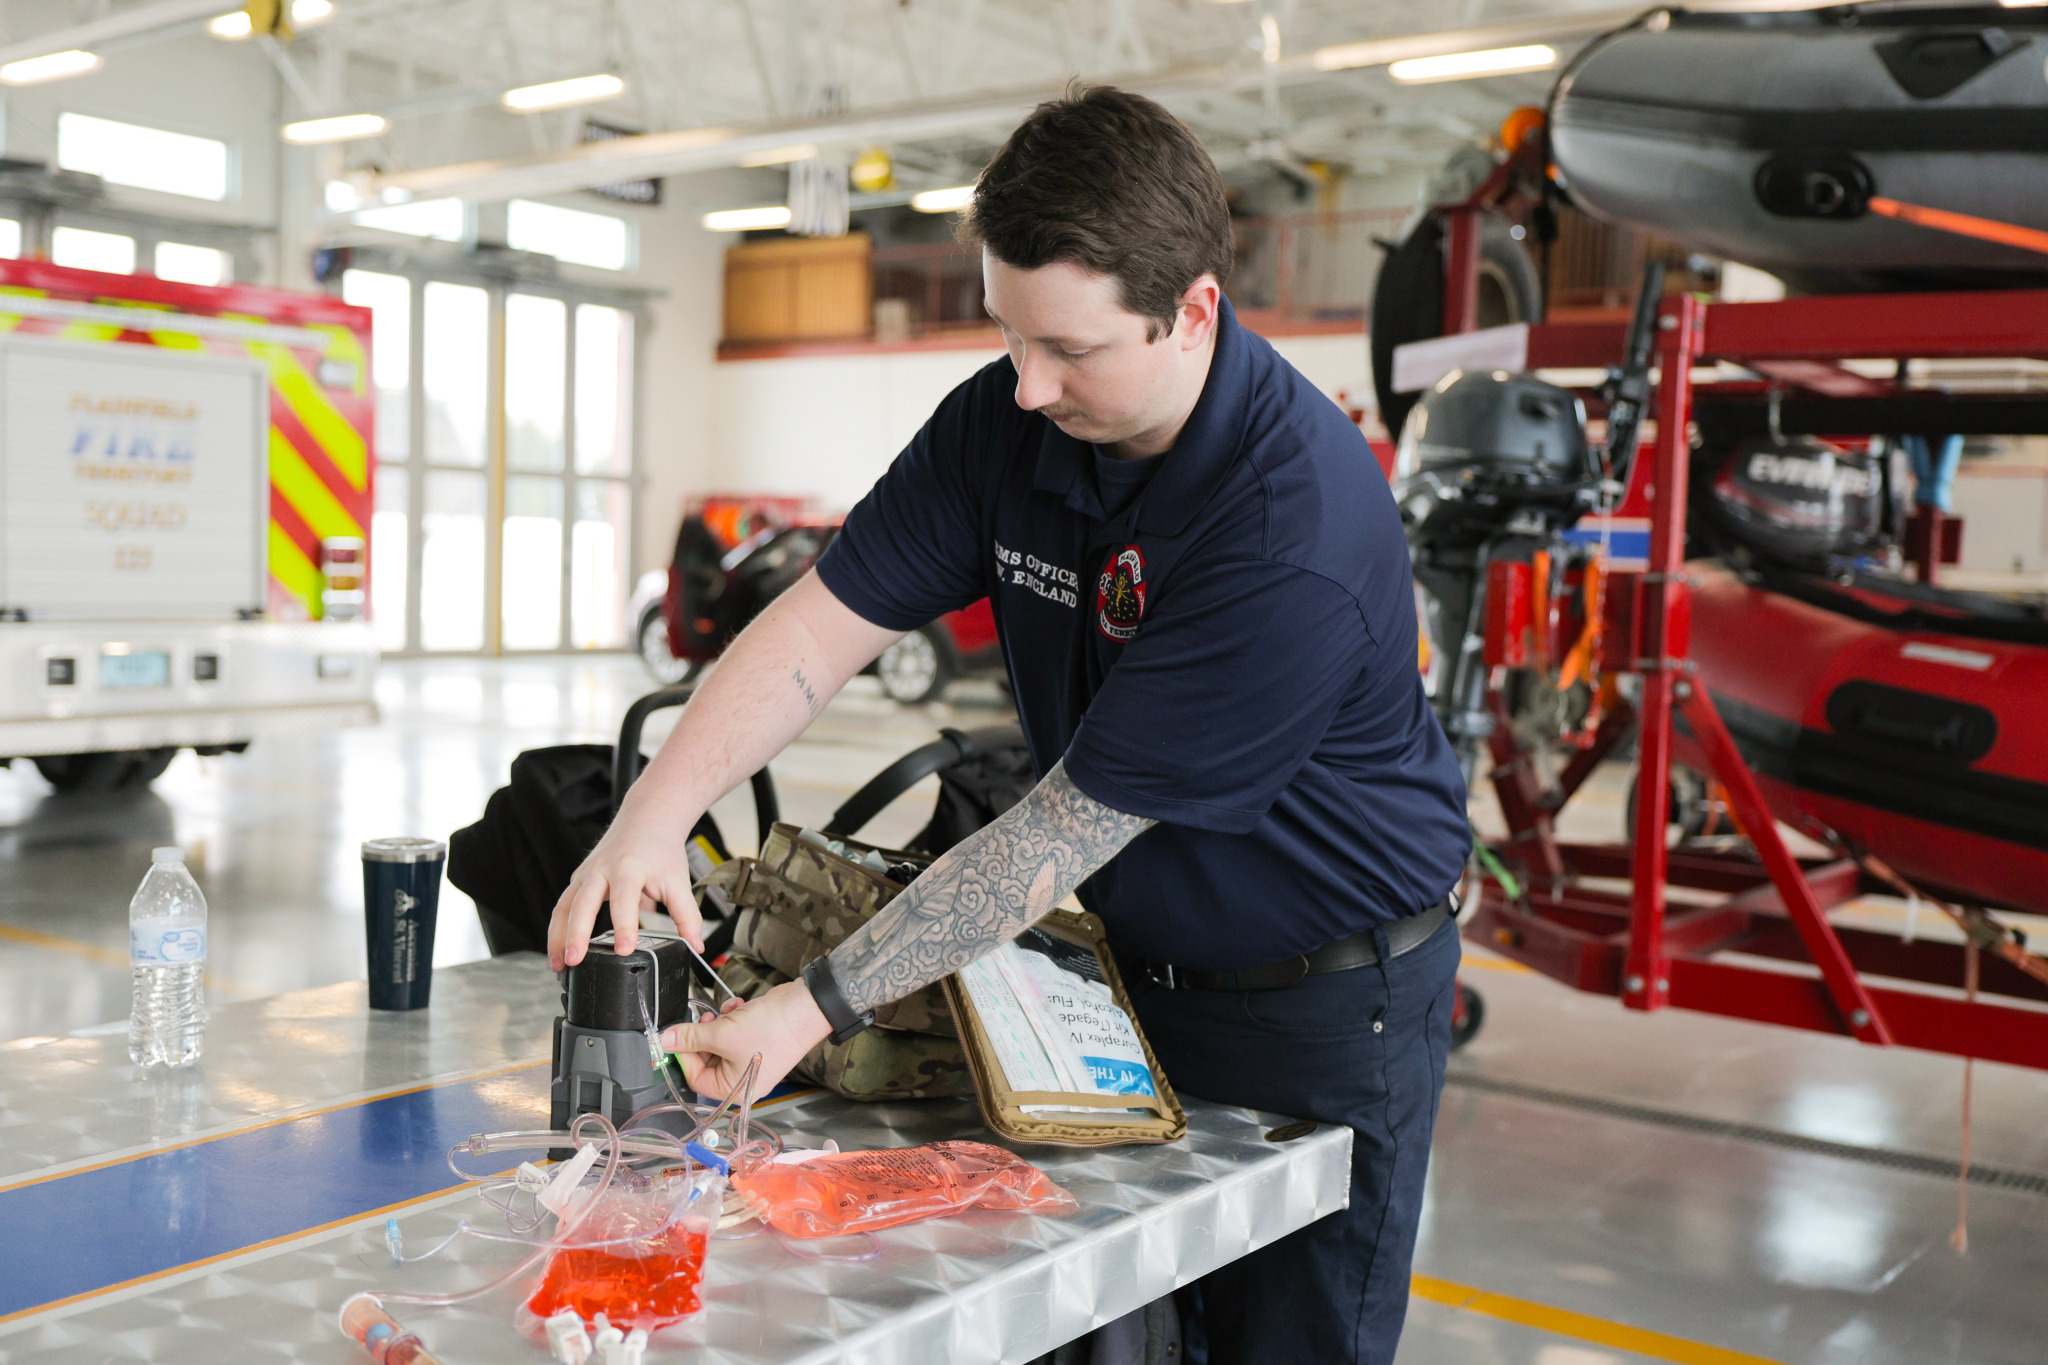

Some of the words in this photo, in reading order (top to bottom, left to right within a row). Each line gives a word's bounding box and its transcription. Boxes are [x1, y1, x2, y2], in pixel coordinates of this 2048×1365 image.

[71, 427, 195, 460] FIRE
[84, 500, 188, 531] SQUAD
[1026, 554, 1078, 592] OFFICE
[1012, 571, 1076, 608] ENGLAND
[1070, 1032, 1083, 1044] IV
[1114, 1022, 1130, 1036] Kit
[1087, 1033, 1141, 1055] Curaplex
[1120, 1070, 1135, 1087] IV
